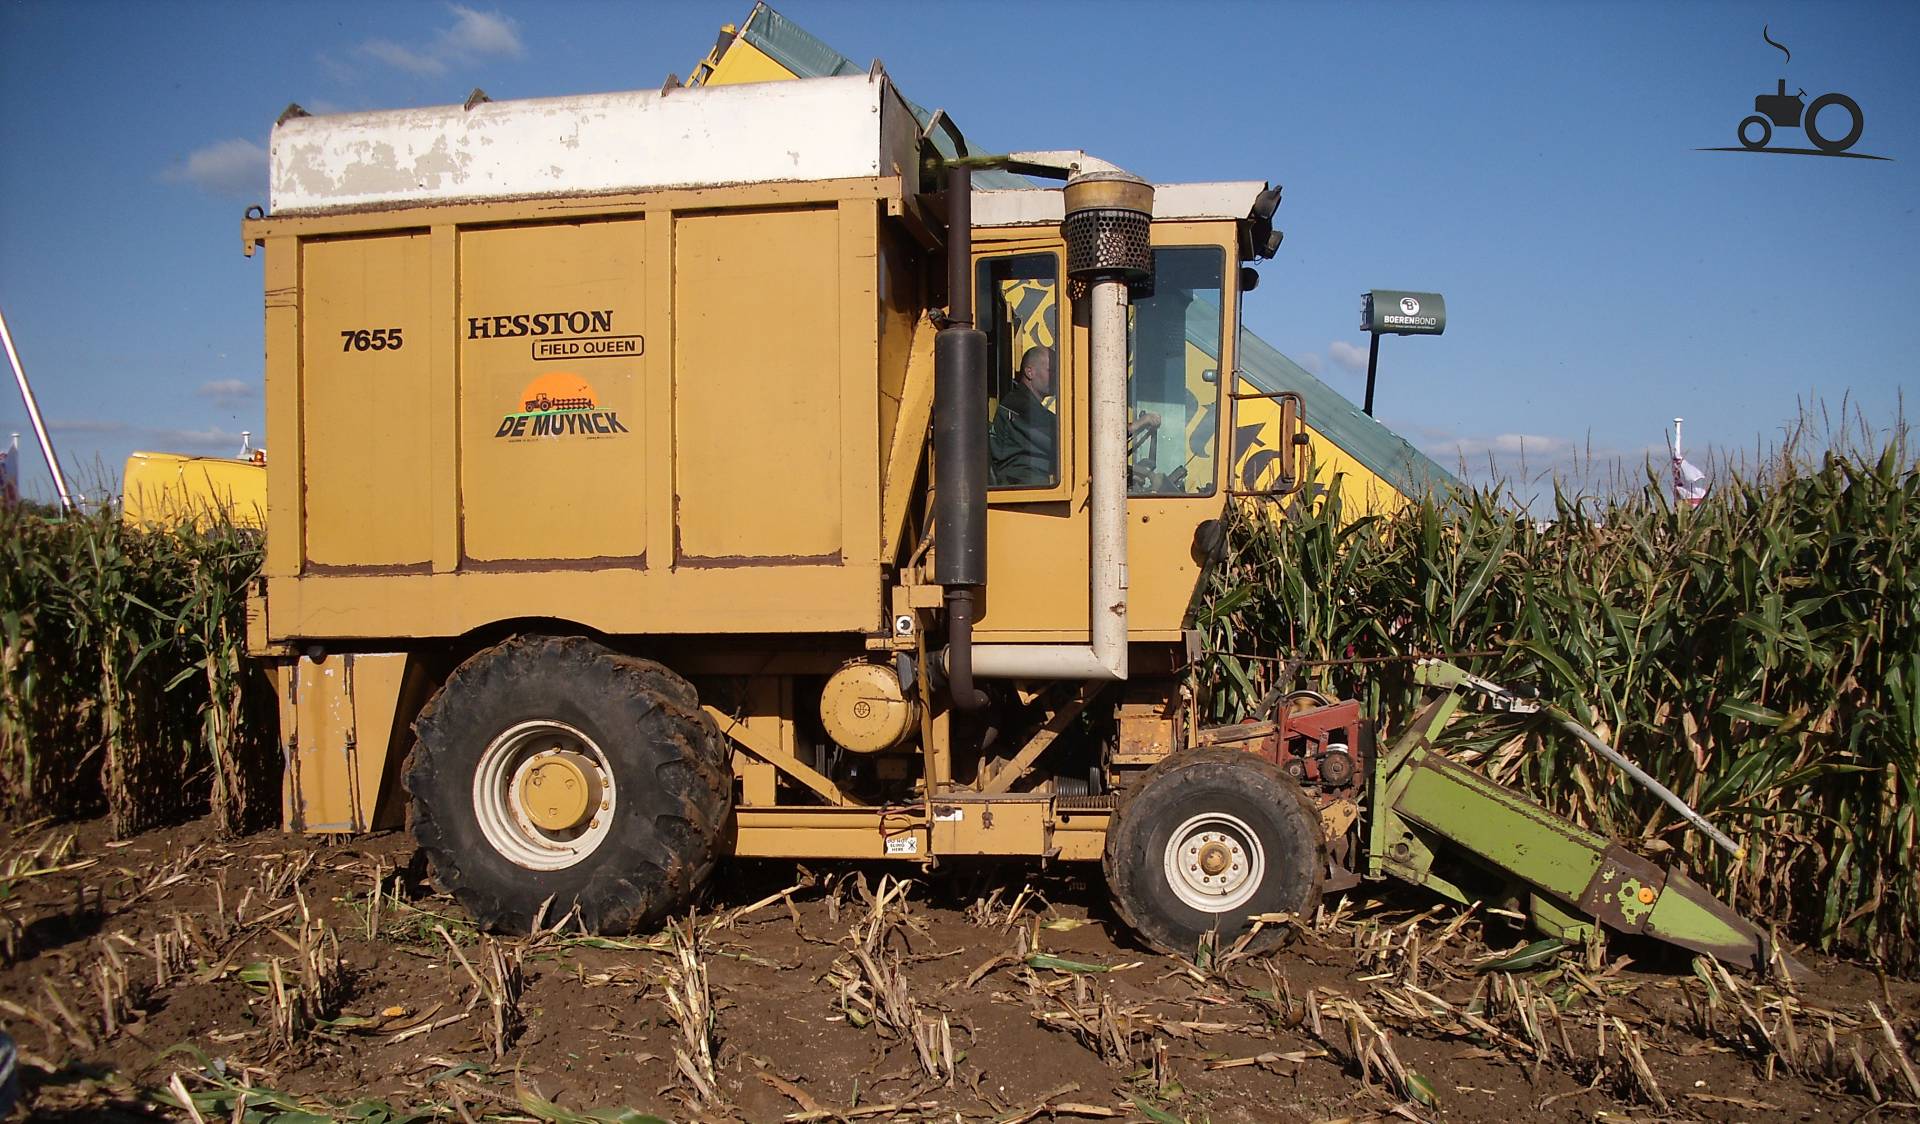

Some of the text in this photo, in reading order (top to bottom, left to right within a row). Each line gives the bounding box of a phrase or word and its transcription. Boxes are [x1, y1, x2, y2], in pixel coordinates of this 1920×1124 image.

[468, 310, 613, 339] HESSTON
[1384, 315, 1436, 325] BOERENBOND
[341, 328, 403, 352] 7655
[540, 341, 636, 356] FIELD QUEEN
[495, 412, 629, 438] DE MUYNCK
